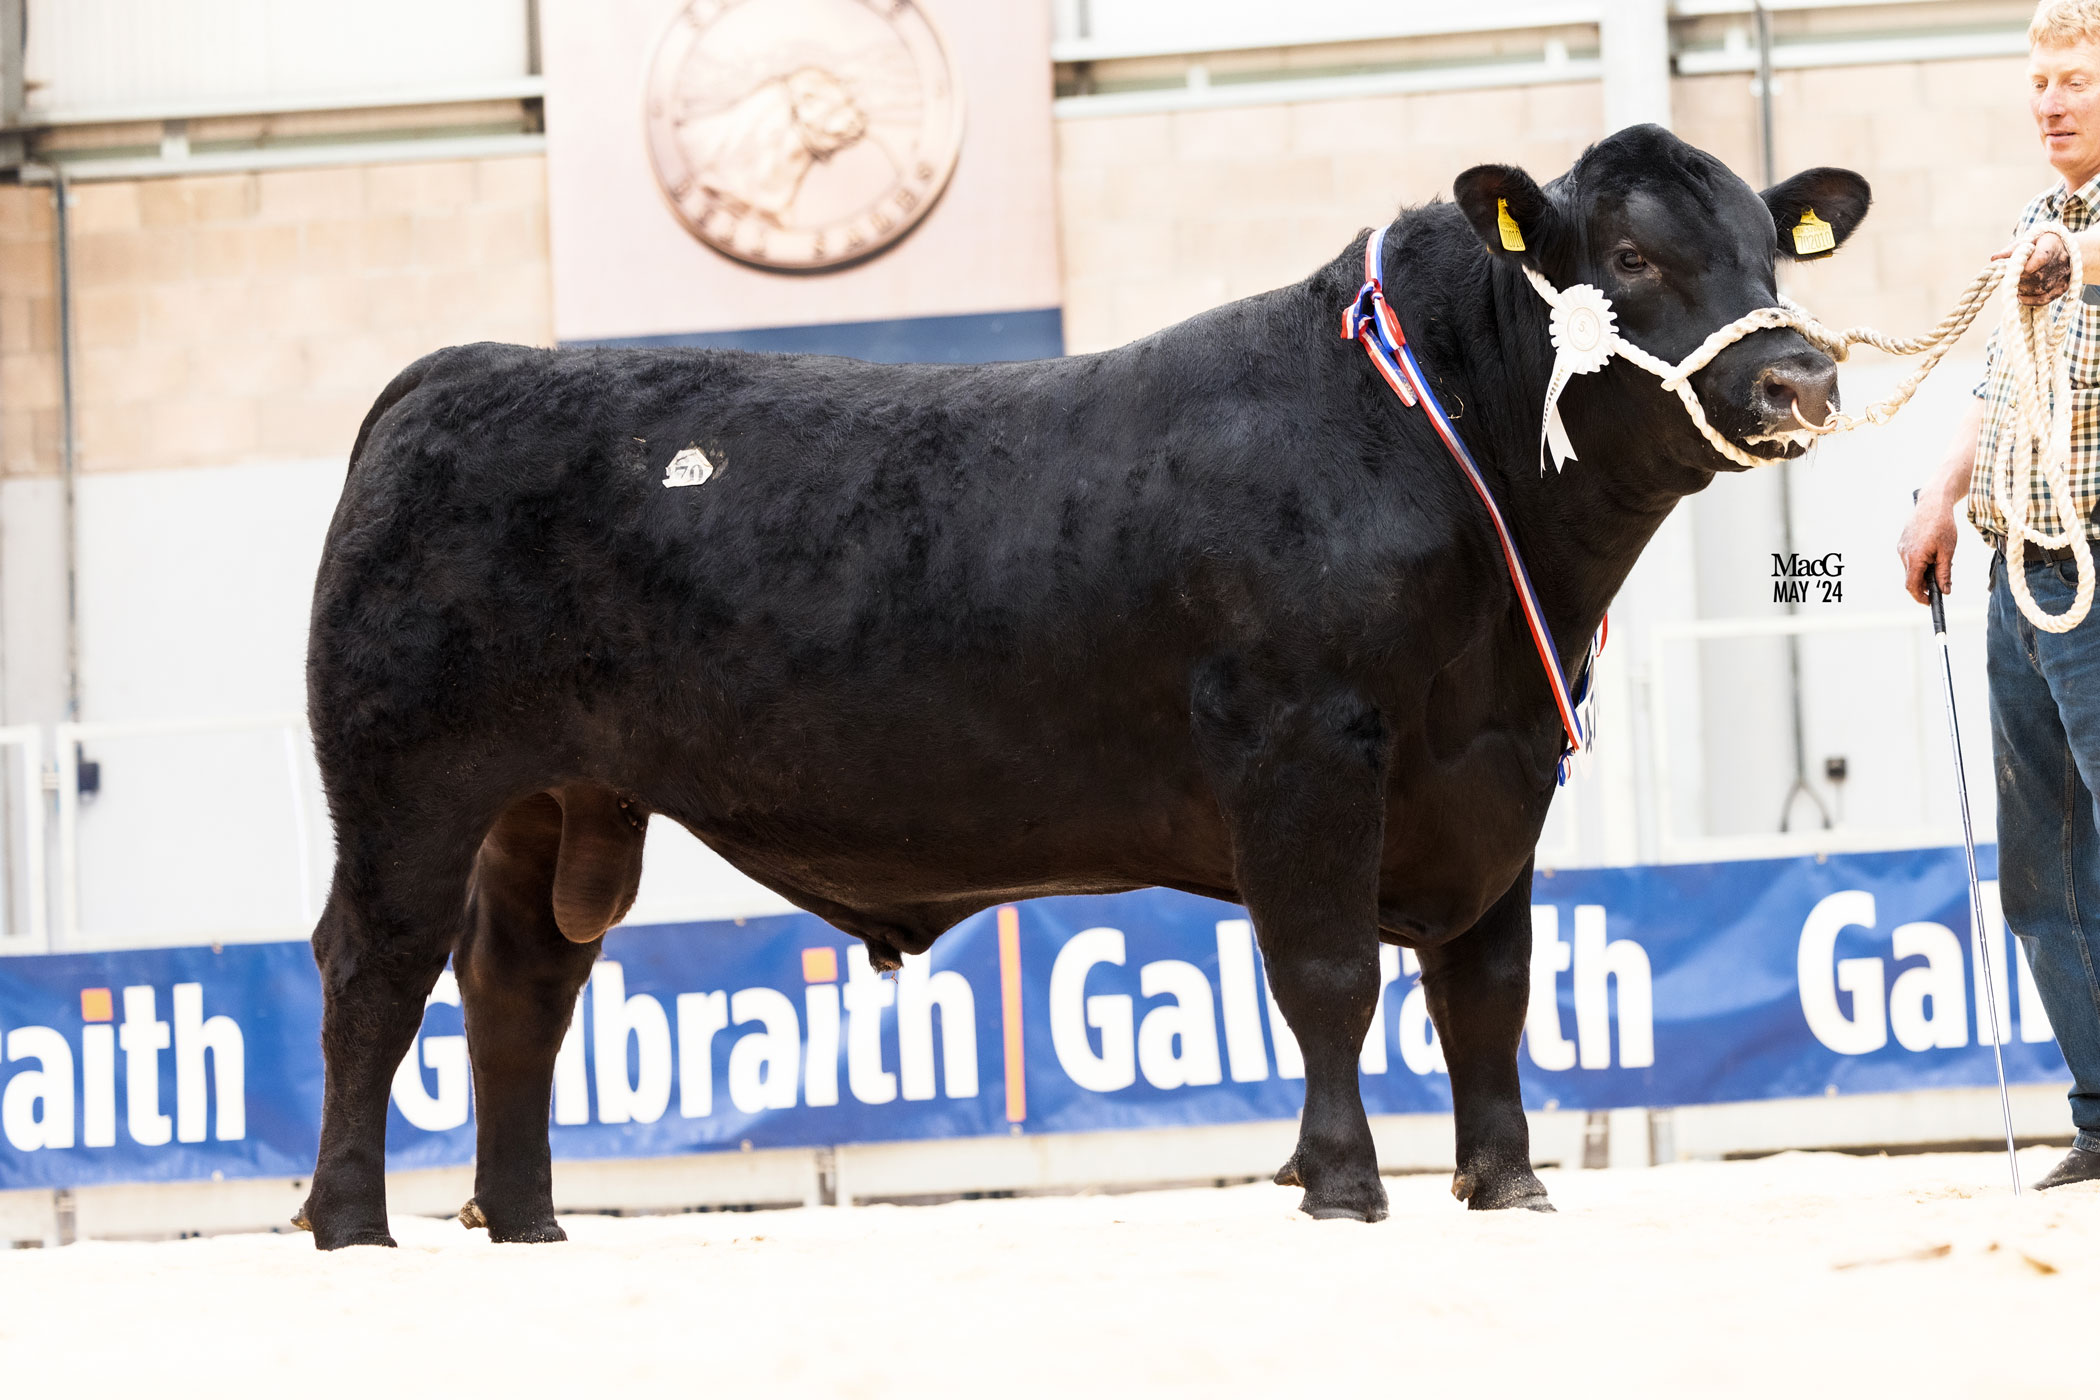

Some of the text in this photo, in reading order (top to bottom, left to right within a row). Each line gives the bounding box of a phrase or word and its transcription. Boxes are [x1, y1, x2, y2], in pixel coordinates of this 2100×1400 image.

[675, 464, 703, 482] 70
[0, 982, 246, 1151] aith
[391, 944, 978, 1131] Glbraith
